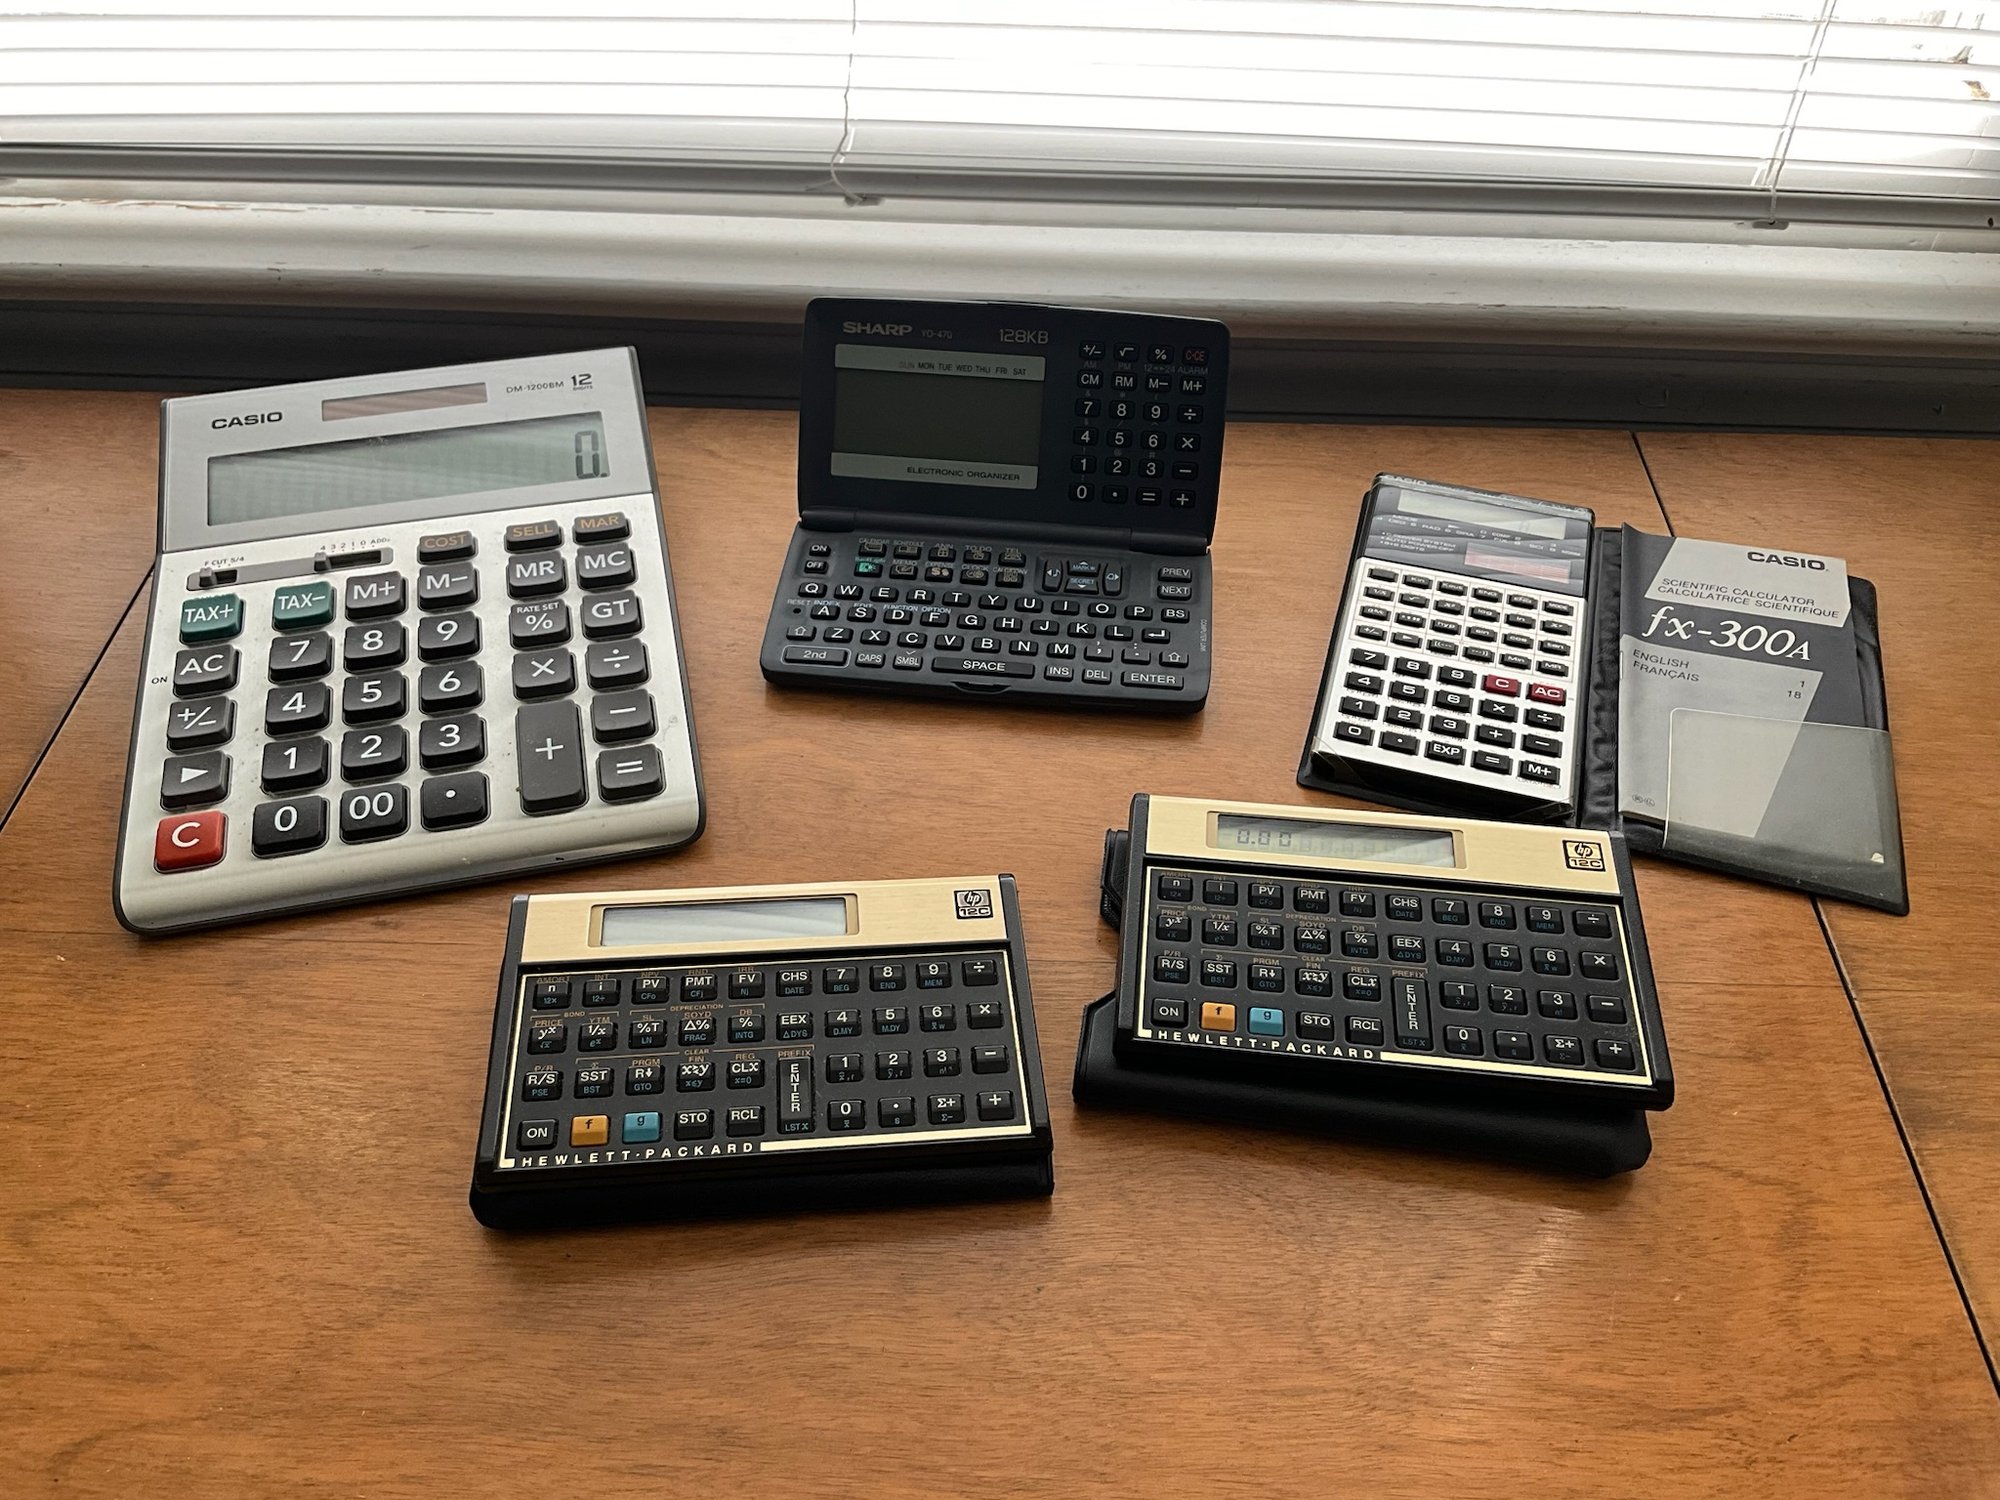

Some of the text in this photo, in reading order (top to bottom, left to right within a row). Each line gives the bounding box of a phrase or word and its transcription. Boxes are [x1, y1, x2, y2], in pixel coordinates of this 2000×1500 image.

[843, 322, 912, 336] SHARP
[1000, 329, 1048, 344] 128KB
[957, 364, 972, 372] WED
[976, 365, 990, 373] THU
[506, 380, 564, 393] DM-1200BM
[571, 374, 592, 386] 12
[1081, 375, 1099, 385] CM
[1115, 376, 1133, 387] RM
[1183, 381, 1202, 391] M+
[212, 412, 282, 429] CASIO
[907, 466, 1020, 482] ELECTRONIC ORGANIZER
[423, 514, 620, 549] COST SELL MAR
[231, 556, 244, 564] 5/4
[807, 561, 823, 569] OFF
[1747, 552, 1825, 571] CASIO
[352, 582, 395, 601] M+
[516, 561, 555, 577] MR
[585, 551, 625, 569] MC
[1162, 568, 1189, 576] PREV
[805, 583, 819, 594] Q
[840, 586, 857, 594] W
[879, 588, 890, 597] E
[914, 590, 927, 599] R
[952, 593, 965, 601] T
[987, 595, 1000, 604] Y
[1023, 599, 1035, 608] U
[1096, 604, 1109, 613] O
[1134, 607, 1145, 616] P
[1166, 610, 1185, 618] BS
[1662, 578, 1815, 606] SCIENTIFIC CALCULATOR
[516, 602, 560, 613] RATE SET
[591, 599, 630, 618] GT
[1657, 586, 1839, 618] CALCULATRICE SCIENTIFIQUE
[185, 604, 233, 622] TAX+
[289, 620, 458, 662] 7 8 9
[803, 651, 1176, 683] 2nd CAPS SMBL SPACE INS DEL ENTER
[1633, 649, 1690, 669] ENGLISH
[151, 654, 223, 685] ON AC
[1496, 679, 1560, 697] C AC
[1633, 661, 1802, 699] FRANÇAIS 18
[282, 670, 461, 713] 4 5 6
[283, 724, 460, 769] 1 2 3
[1433, 744, 1460, 755] EXP
[1528, 765, 1551, 776] M+
[275, 793, 393, 831] 0 00
[171, 821, 201, 847] C
[1570, 859, 1602, 867] 12C
[1259, 886, 1418, 908] PV PMT FV CHS
[960, 907, 991, 916] 12C
[1396, 938, 1421, 948] EEX
[1161, 959, 1184, 970] R/S
[1207, 964, 1231, 974] SST
[643, 972, 807, 989] PV PMT FV CHS
[785, 979, 942, 995] DATE BEG END MEM
[1159, 984, 1419, 1031] ON STO RCL ENTER
[781, 1015, 807, 1025] EEX
[684, 1031, 753, 1041] FRAC INTG
[528, 1073, 555, 1085] R/S
[580, 1071, 607, 1081] SST
[532, 1082, 652, 1096] PSE BST GTO
[790, 1064, 800, 1112] ENTER
[527, 1128, 548, 1138] ON
[679, 1113, 707, 1124] STO
[731, 1110, 758, 1121] RCL
